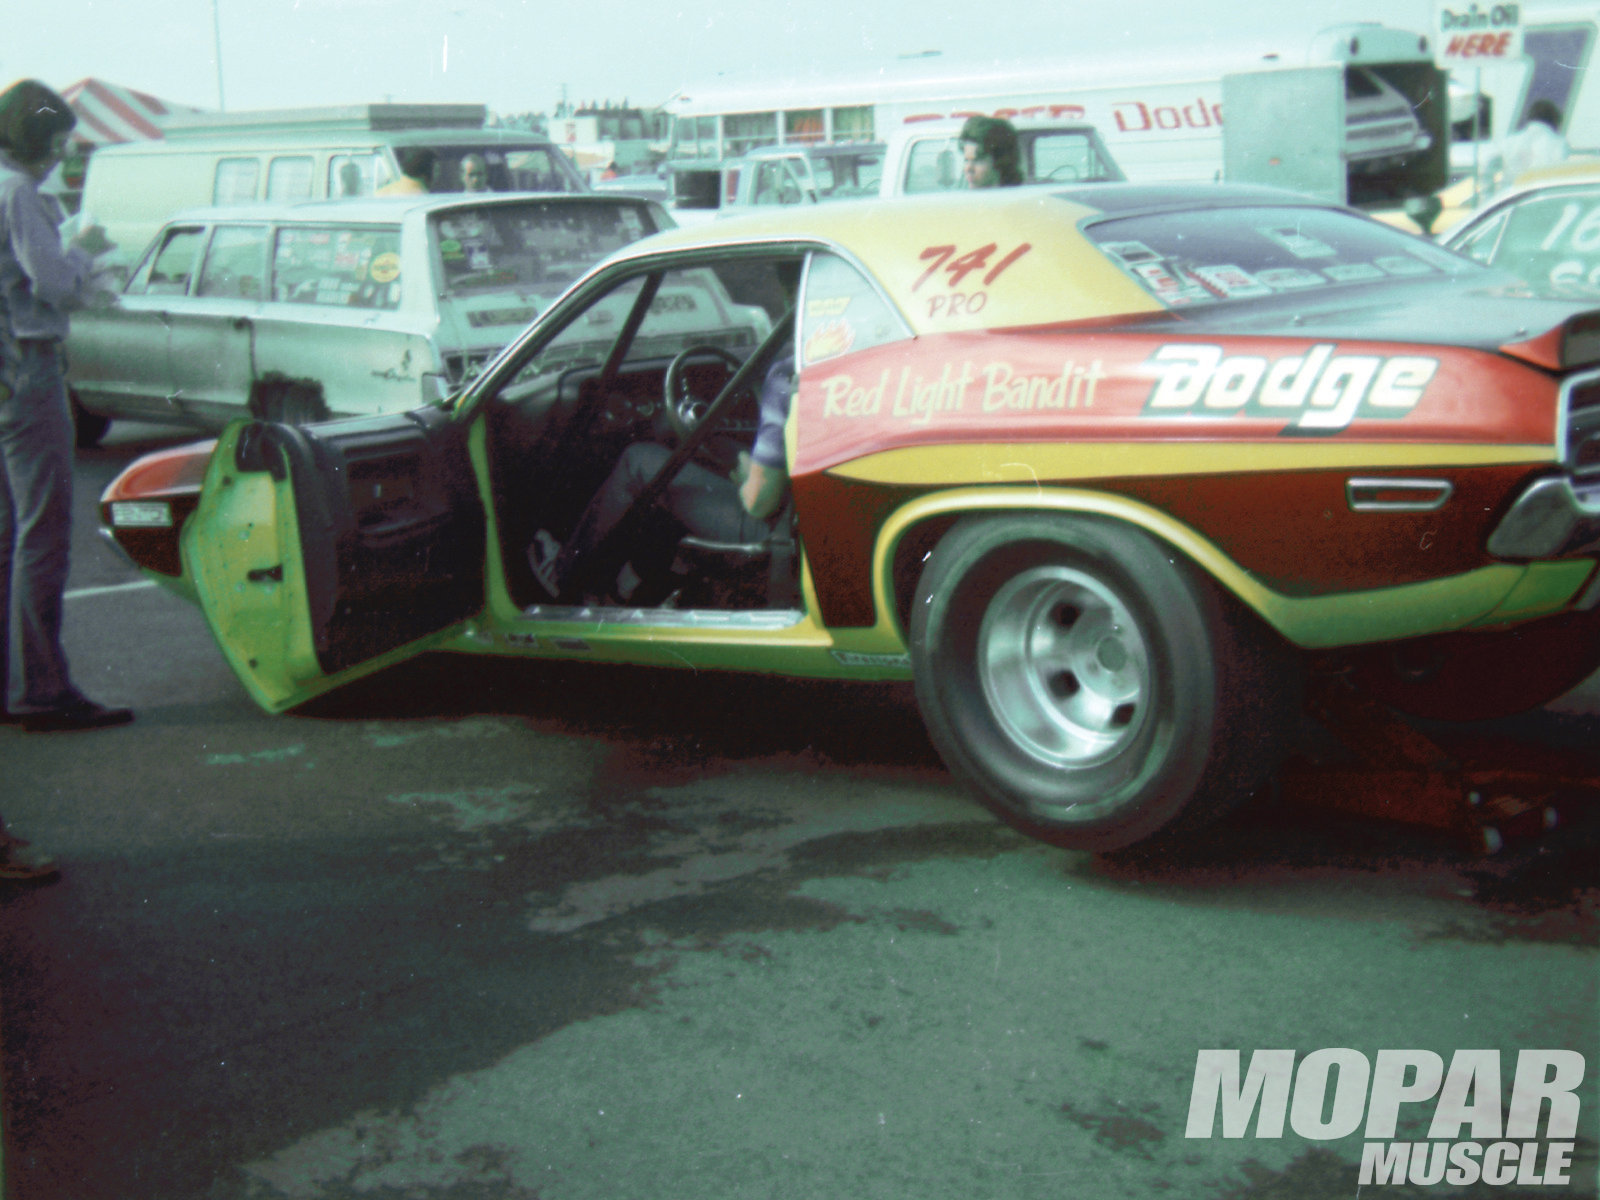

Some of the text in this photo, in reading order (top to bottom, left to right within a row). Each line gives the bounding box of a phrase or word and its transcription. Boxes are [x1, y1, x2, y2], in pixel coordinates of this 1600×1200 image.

[1440, 4, 1488, 30] Drain
[1445, 32, 1512, 57] HERE
[911, 243, 1032, 292] 741
[927, 291, 988, 318] PRO
[820, 358, 1106, 426] Red Light Bandit
[1137, 343, 1440, 432] Dodge
